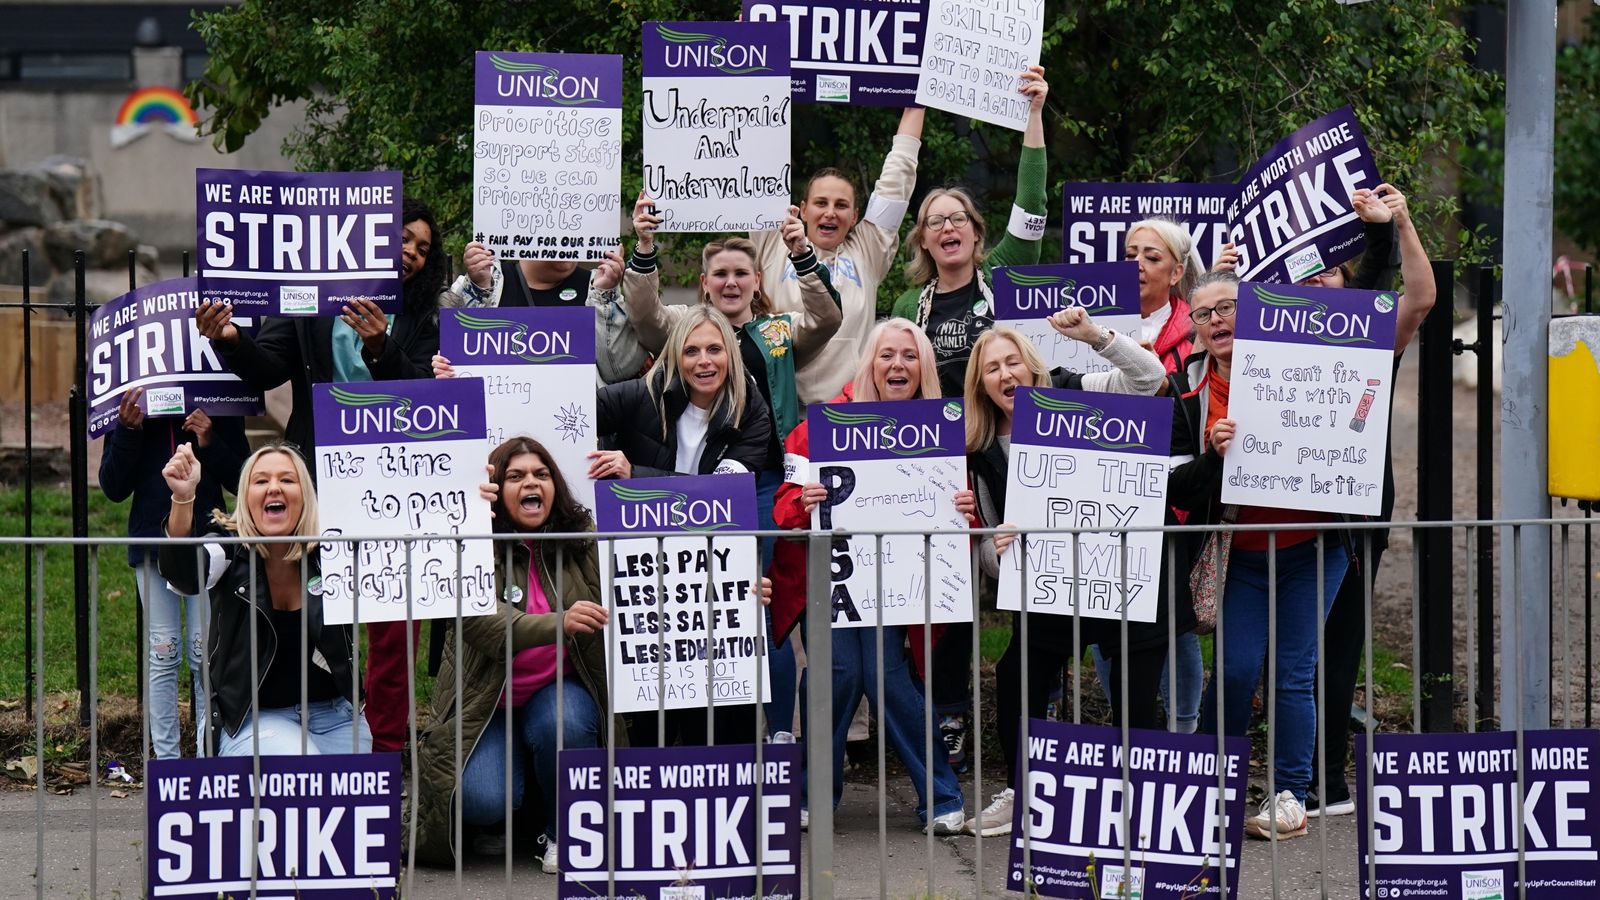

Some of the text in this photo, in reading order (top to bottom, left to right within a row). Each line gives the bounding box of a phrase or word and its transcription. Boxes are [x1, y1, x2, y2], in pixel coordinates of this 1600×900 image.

[940, 1, 1032, 46] SKILLED
[665, 44, 767, 68] UNISON
[934, 32, 1028, 73] STAFF HUNG
[497, 74, 599, 99] UNISON
[819, 81, 848, 89] UNISON
[926, 55, 955, 76] OUT
[960, 63, 980, 83] TO
[983, 69, 1014, 92] DRY
[858, 86, 917, 95] #PayUpForCouncilSta
[479, 108, 612, 138] Prioritise
[643, 88, 790, 140] Underpaid
[565, 139, 621, 170] staff
[694, 130, 740, 160] And
[484, 167, 598, 186] so we can
[644, 163, 791, 201] Undervalued
[1227, 122, 1354, 225] WE ARE WORTH MORE
[204, 183, 394, 206] WE ARE WORTH MORE
[1070, 195, 1094, 214] WE
[1100, 196, 1131, 214] ARE
[1138, 196, 1192, 214] WORTH
[501, 208, 583, 235] Pupils
[1230, 147, 1367, 278] STRIKE
[205, 211, 394, 271] STRIKE
[488, 235, 509, 246] FAIR
[513, 235, 534, 246] PAY
[537, 236, 558, 247] FOR
[561, 236, 584, 247] OUR
[588, 236, 621, 247] SKILLS
[500, 249, 515, 258] WE
[519, 249, 539, 259] CAN
[283, 292, 316, 300] UNISON
[1015, 284, 1116, 310] UNISON
[93, 290, 199, 339] WE ARE WORTH
[940, 321, 966, 336] MYLES
[1258, 307, 1371, 338] UNISON
[463, 331, 571, 356] UNISON
[1242, 354, 1361, 384] You can't fix
[150, 393, 182, 402] UNISON
[1253, 383, 1351, 405] this with
[340, 404, 459, 435] UNISON
[1035, 412, 1147, 443] UNISON
[1280, 410, 1323, 428] glue
[832, 423, 940, 451] UNISON
[1242, 434, 1367, 466] Our pupils
[323, 446, 452, 479] It's time
[1017, 451, 1164, 499] UP THE
[1228, 466, 1378, 497] deserve better
[361, 489, 468, 531] to pay
[621, 499, 731, 529] UNISON
[1047, 497, 1140, 538] PAY
[614, 547, 731, 579] LESS PAY
[1012, 538, 1152, 583] WE WILL
[614, 580, 750, 608] LESS STAFF
[1033, 574, 1144, 613] STAY
[618, 608, 741, 636] LESS SAFE
[620, 640, 672, 665] LESS
[632, 665, 671, 682] LESS
[679, 664, 694, 679] IS
[1028, 736, 1059, 763] WE
[1065, 742, 1105, 767] ARE
[1111, 745, 1182, 774] WORTH
[1372, 752, 1399, 775] WE
[1407, 752, 1449, 775] ARE
[1531, 747, 1590, 771] MORE
[158, 771, 391, 802] WE ARE WORTH MORE
[568, 767, 601, 790] WE
[614, 765, 652, 789] ARE
[659, 763, 730, 789] WORTH
[1022, 770, 1238, 856] STRIKE
[1373, 780, 1592, 853] STRIKE
[158, 805, 391, 883] STRIKE
[568, 795, 791, 870] STRIKE
[1403, 888, 1448, 897] @unisonedin
[1465, 878, 1501, 889] UNISON
